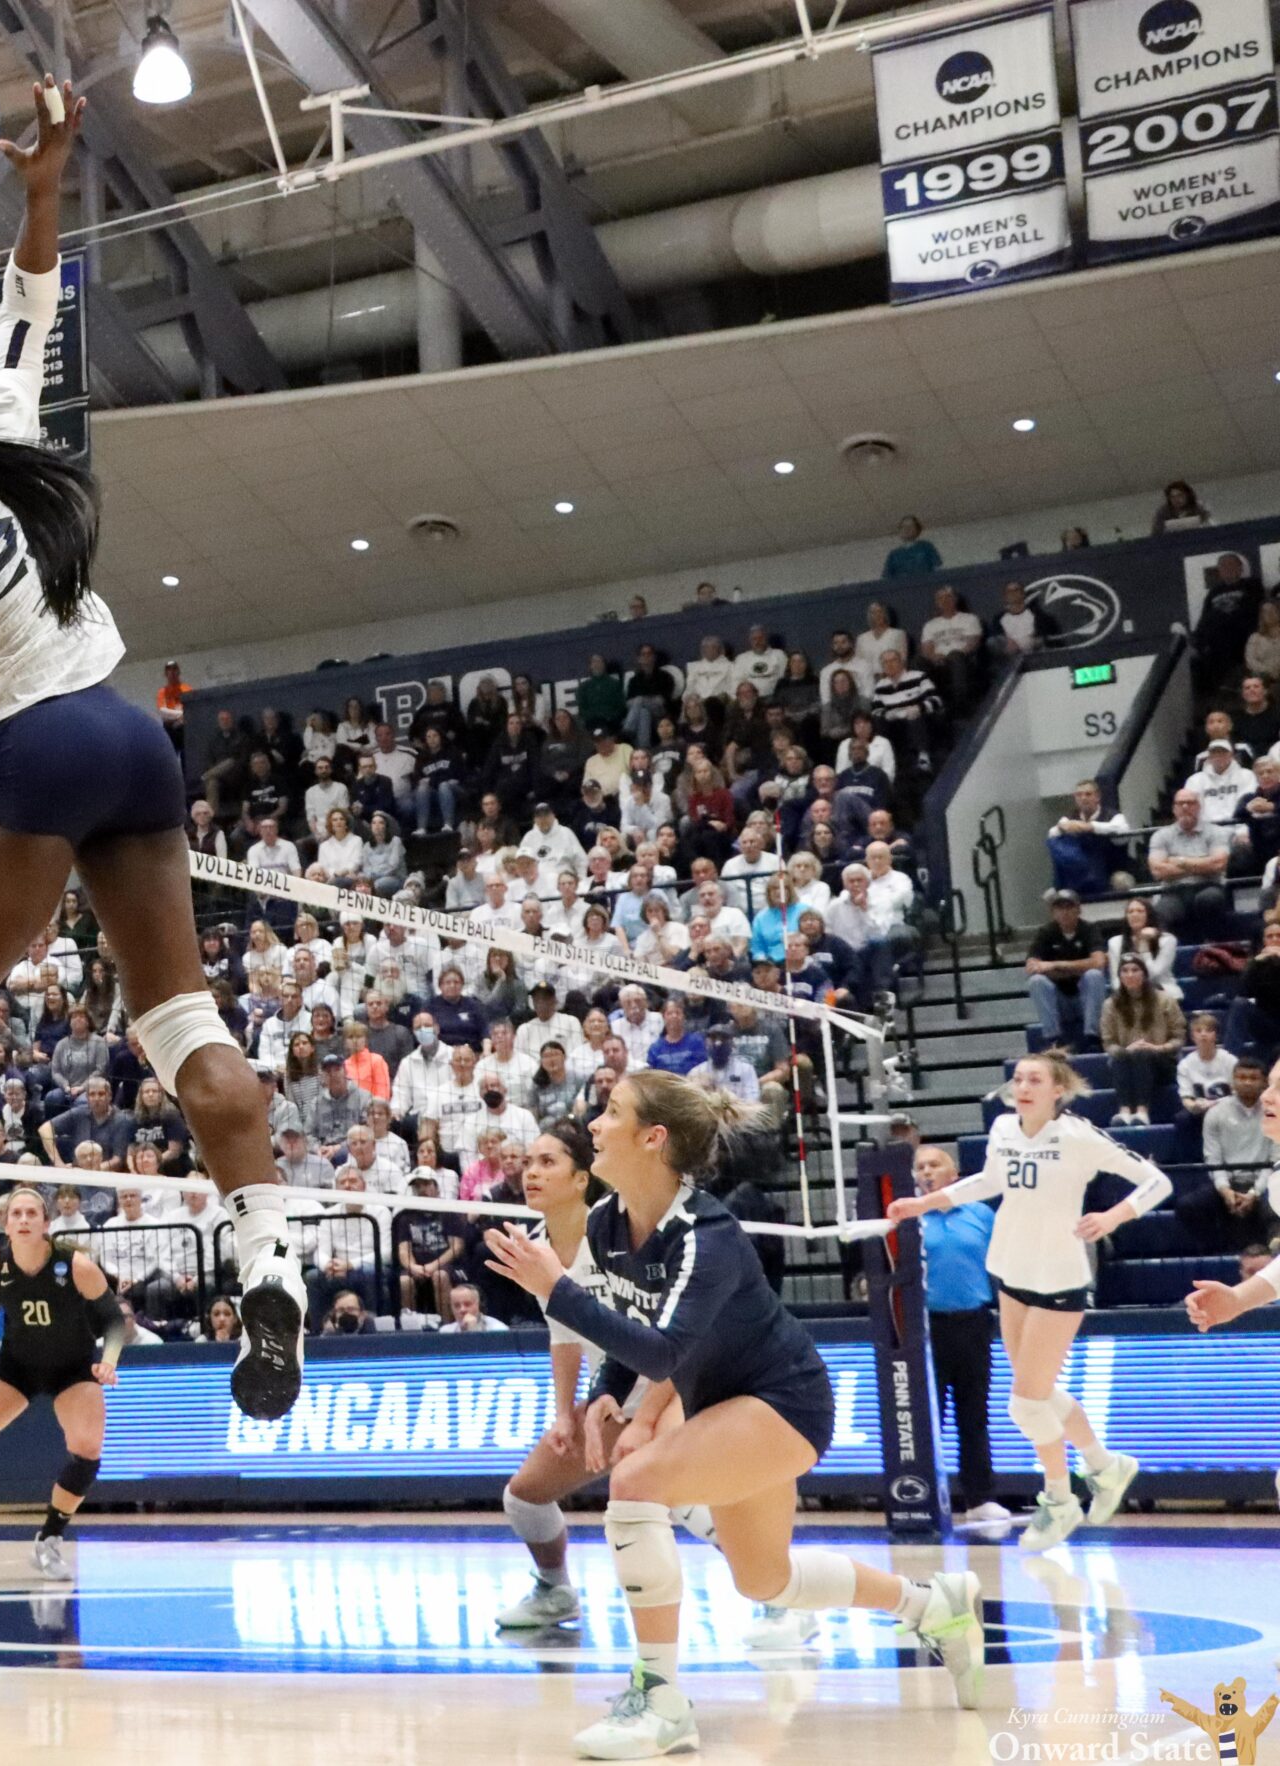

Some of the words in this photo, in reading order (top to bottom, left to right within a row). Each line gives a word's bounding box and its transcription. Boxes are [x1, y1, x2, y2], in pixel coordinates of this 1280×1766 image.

[1144, 18, 1202, 46] NCAA
[941, 69, 995, 96] NCAA
[1094, 40, 1260, 94] CHAMPIONS
[894, 93, 1047, 141] CHAMPIONS
[1087, 88, 1271, 167] 2007
[893, 145, 1051, 208] 1999
[1133, 166, 1237, 202] WOMEN'S
[1117, 181, 1255, 223] VOLLEYBALL
[918, 227, 1045, 265] VOLLEYBALL
[931, 214, 1028, 245] WOMEN'S
[43, 360, 64, 373] 013
[43, 375, 64, 388] 015
[1084, 711, 1116, 737] S3
[195, 852, 291, 893] VOLLEYBALL
[338, 888, 374, 912] PENN
[378, 899, 416, 922] STATE
[421, 909, 495, 942] VOLLEYBALL
[533, 939, 562, 956] PENN
[565, 943, 595, 965] STATE
[600, 953, 660, 979] VOLLEYBALL
[1023, 1150, 1060, 1160] STATE
[1007, 1160, 1037, 1189] 20
[22, 1300, 51, 1326] 20
[892, 1360, 911, 1407] PENN
[896, 1410, 915, 1461] STATE
